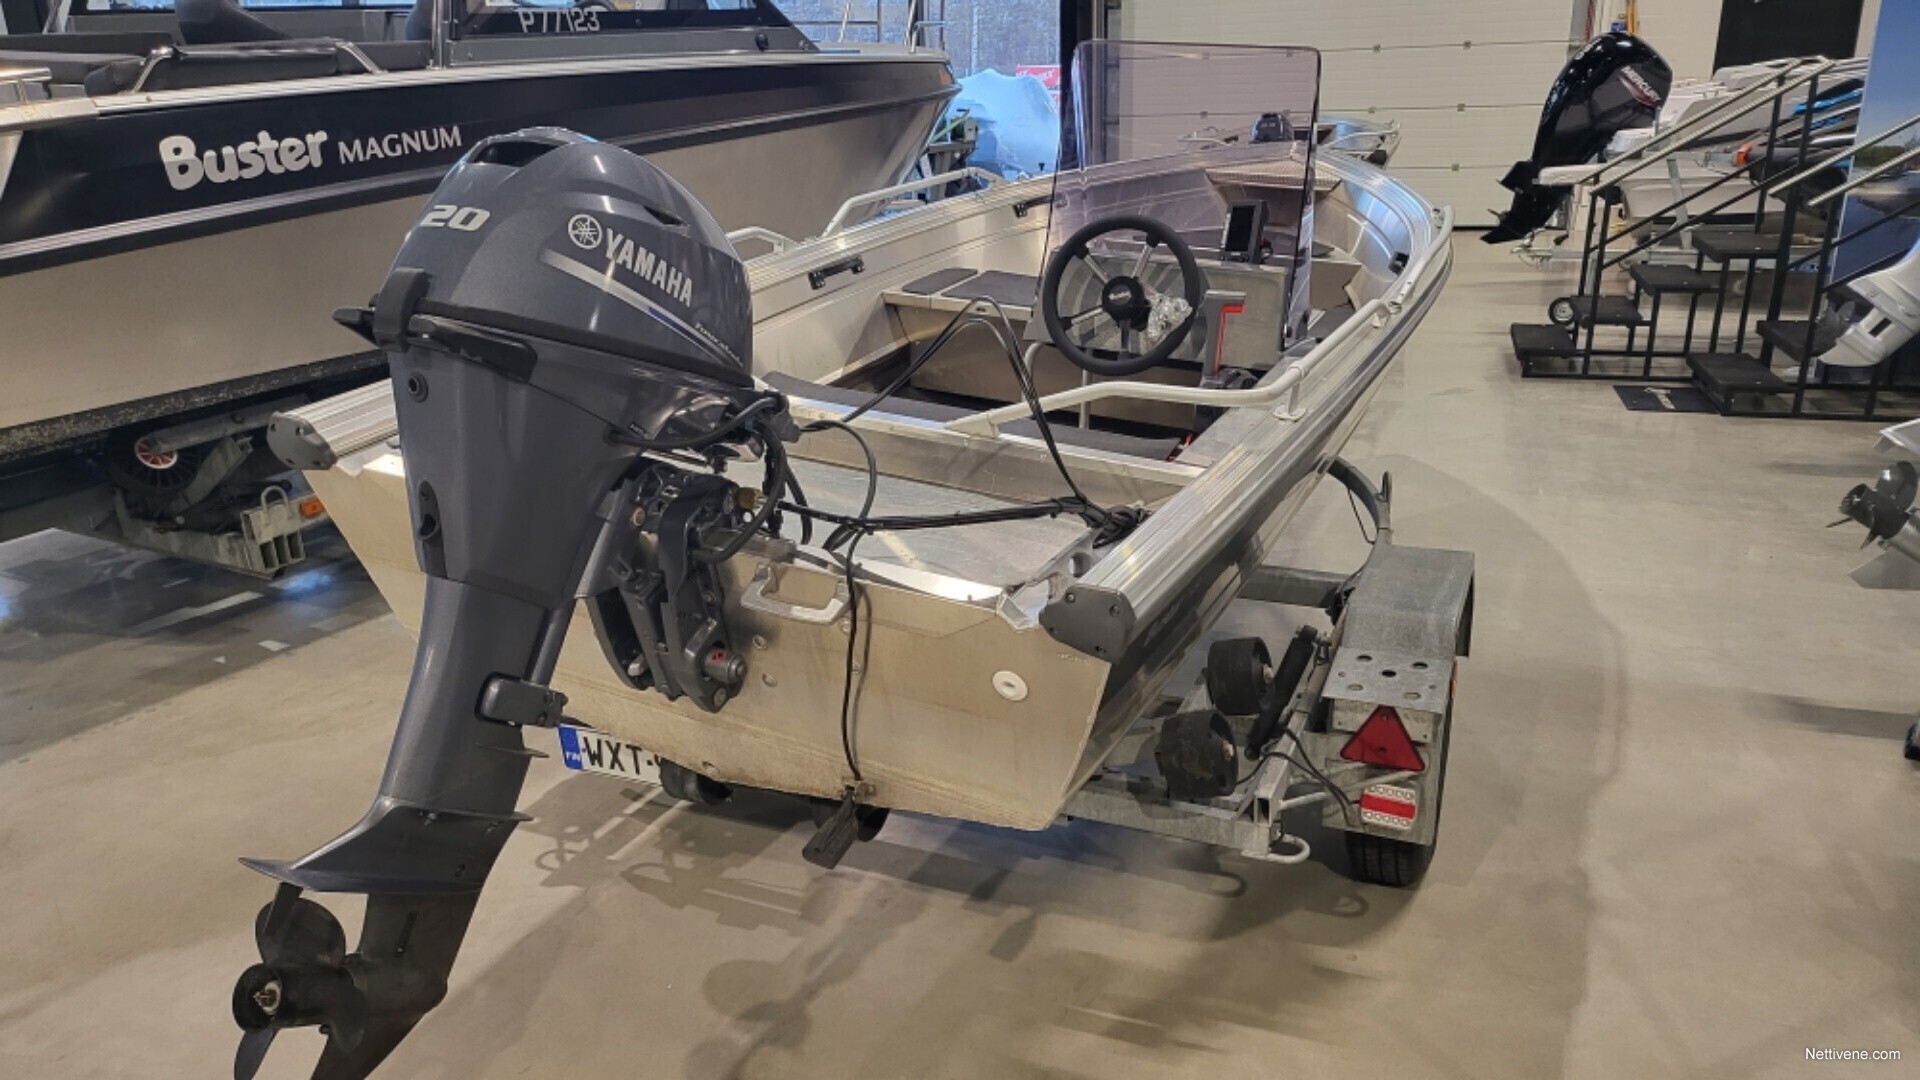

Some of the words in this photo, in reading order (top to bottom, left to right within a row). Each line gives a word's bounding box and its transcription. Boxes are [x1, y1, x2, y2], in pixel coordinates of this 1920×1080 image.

[1621, 65, 1661, 102] MERCURY
[159, 130, 328, 190] Buster
[338, 126, 462, 164] MAGNUM
[420, 205, 490, 232] 20
[605, 228, 693, 308] YAMAHA
